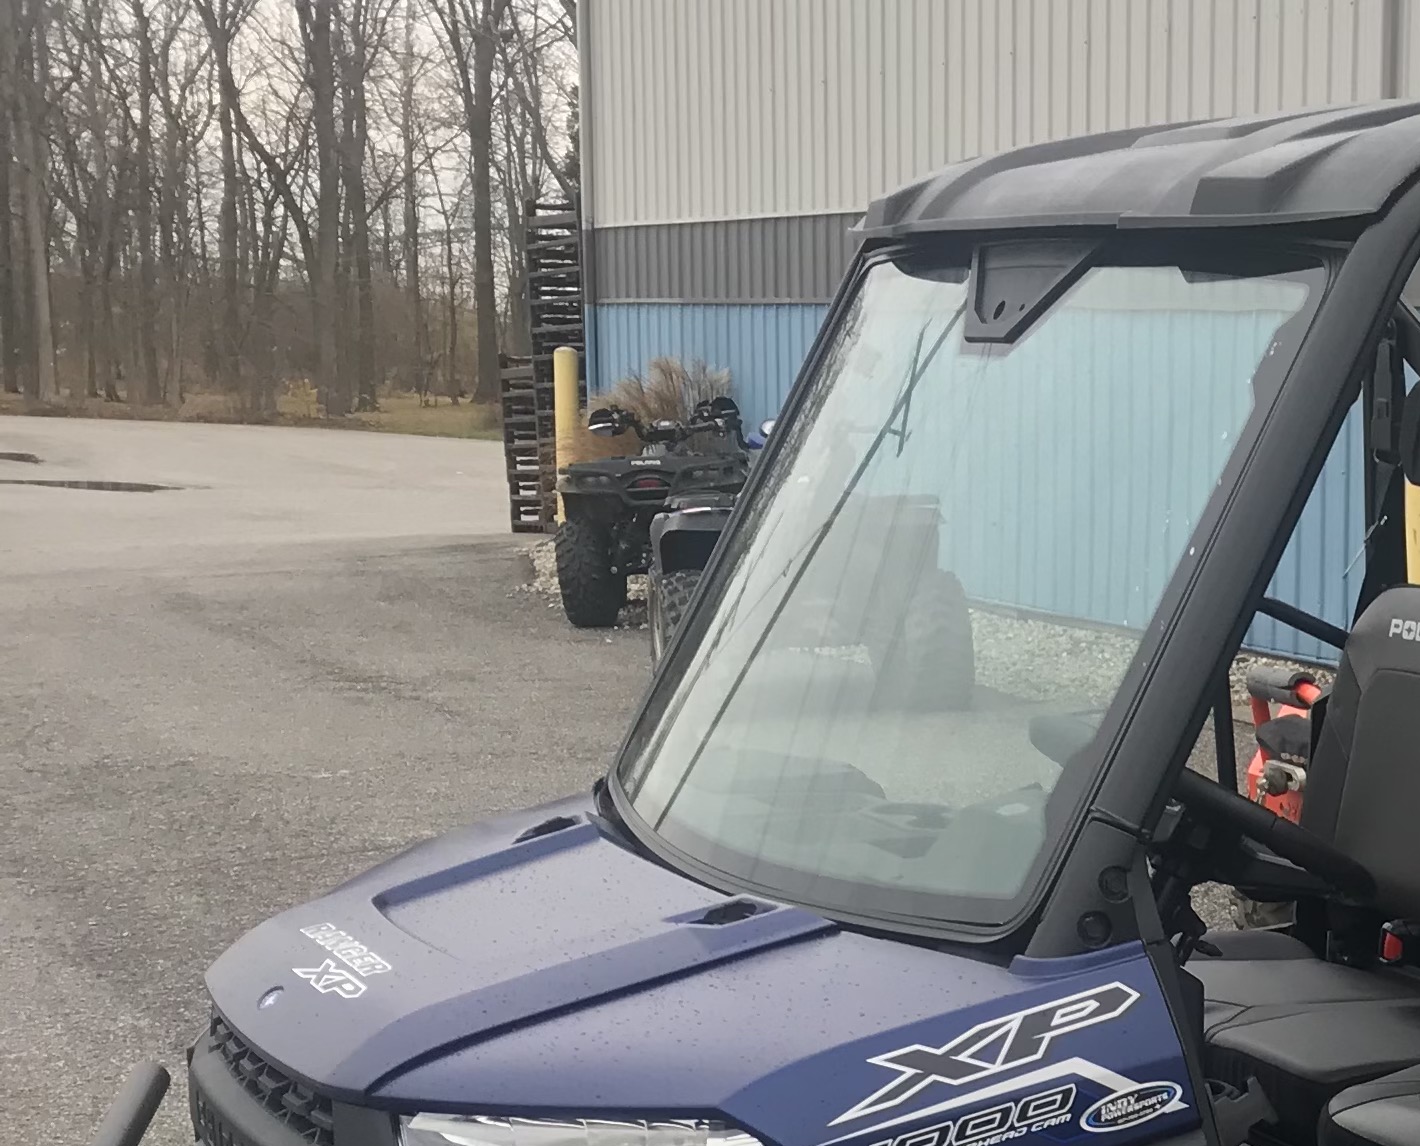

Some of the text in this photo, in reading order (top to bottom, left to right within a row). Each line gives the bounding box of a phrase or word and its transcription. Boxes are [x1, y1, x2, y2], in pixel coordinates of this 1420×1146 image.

[300, 923, 392, 976] RANGER
[292, 958, 367, 998] XP
[827, 981, 1140, 1126] XP
[1100, 1094, 1138, 1115] INDY
[1101, 1092, 1168, 1122] POWERSPORTS
[1031, 1113, 1071, 1132] CAM
